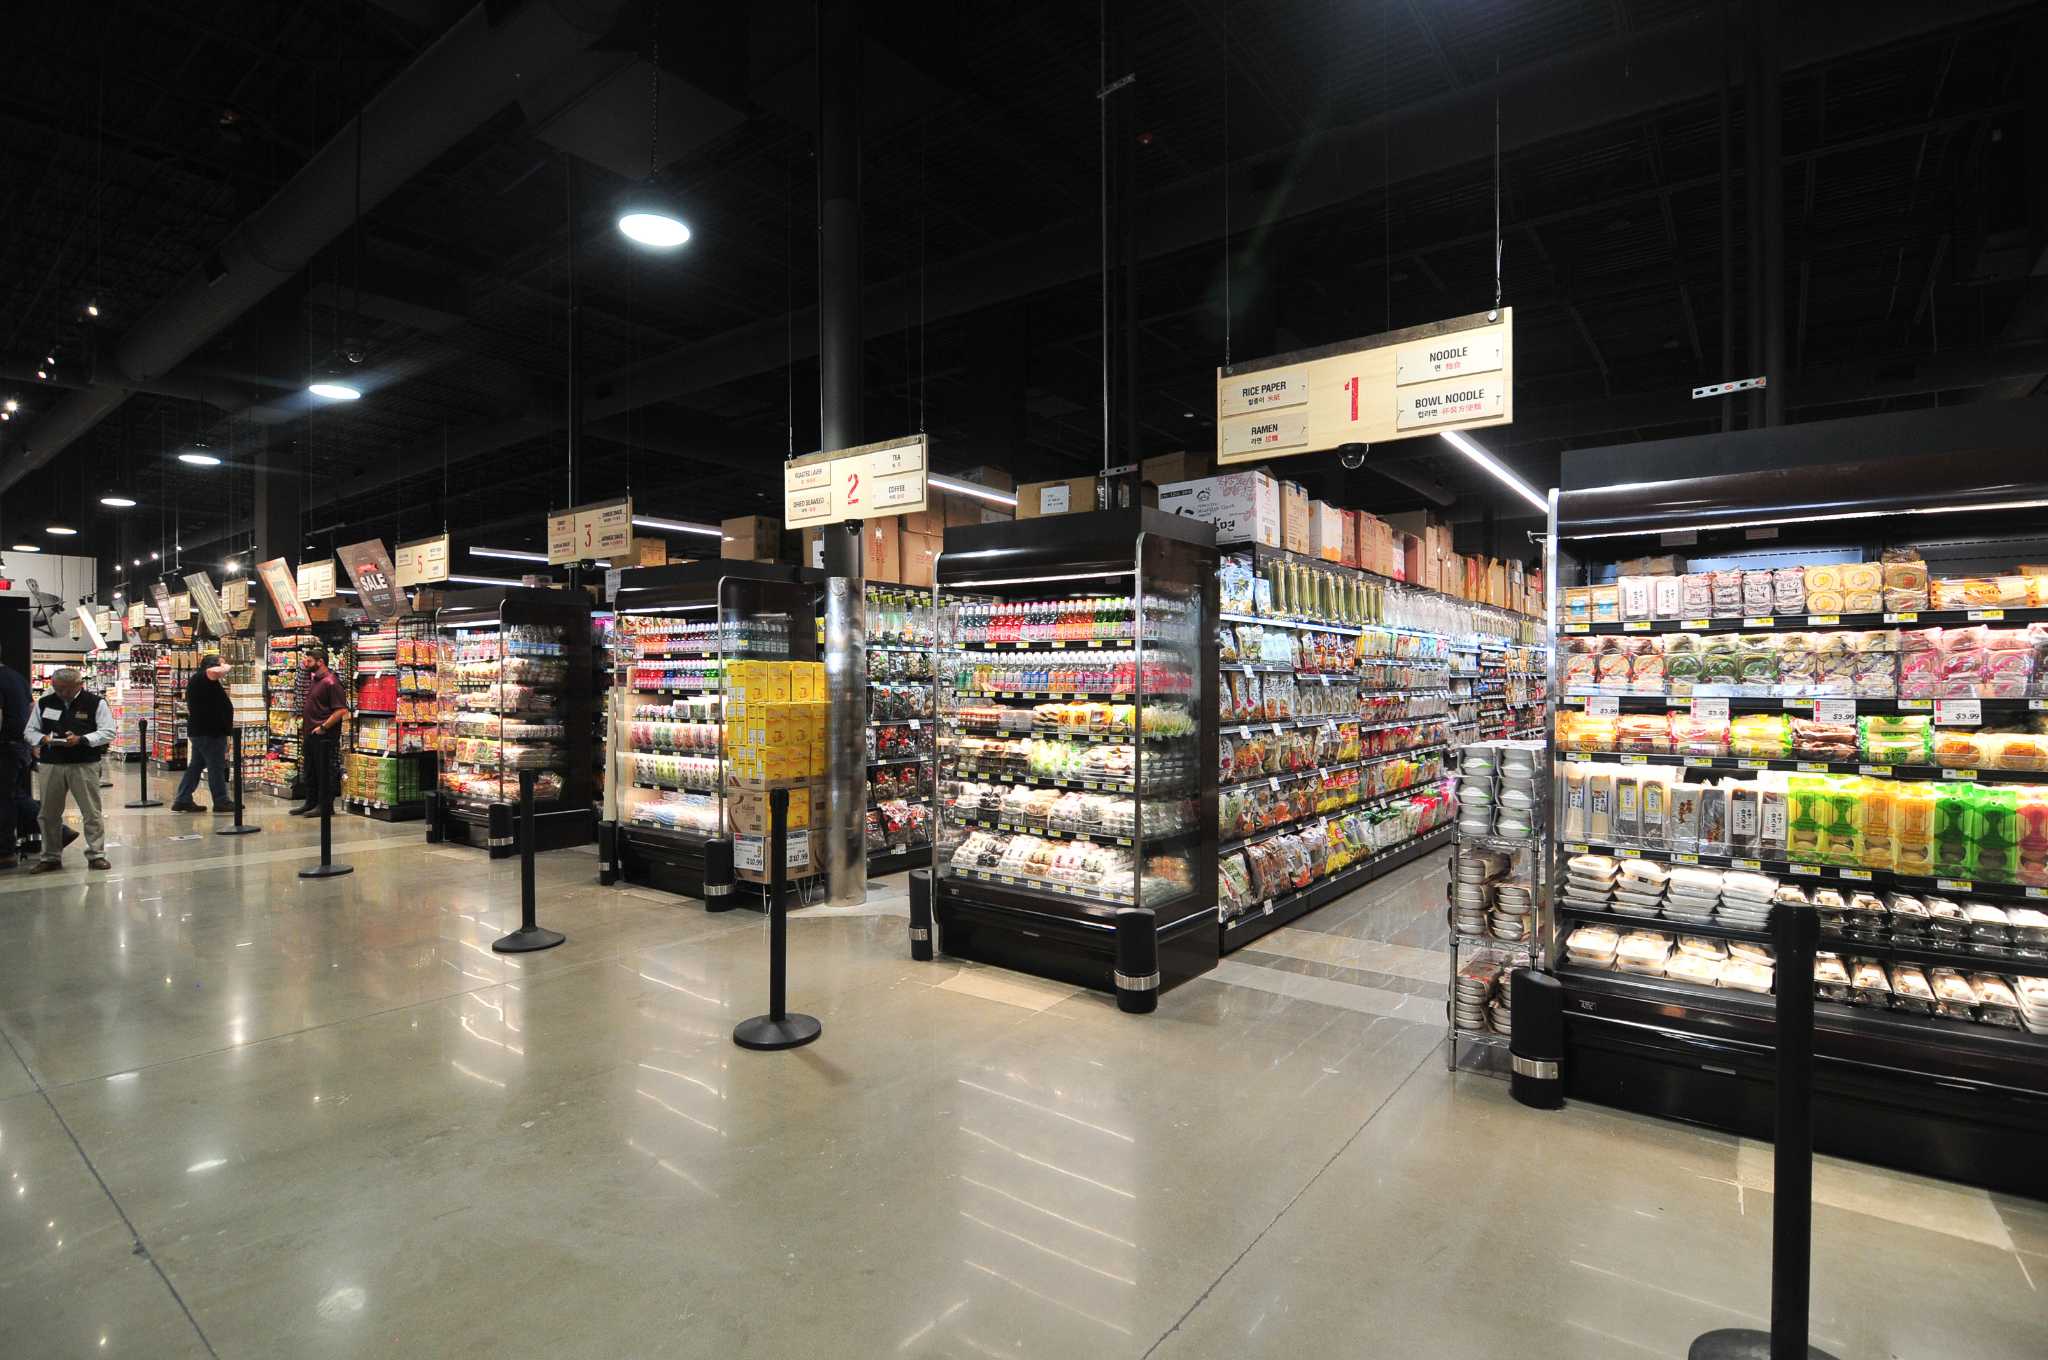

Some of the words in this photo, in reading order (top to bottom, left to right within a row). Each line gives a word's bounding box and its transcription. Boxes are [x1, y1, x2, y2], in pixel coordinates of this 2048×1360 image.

[1429, 346, 1468, 363] NOODLE
[1242, 385, 1260, 397] RICE
[1261, 381, 1287, 393] PAPER
[1344, 377, 1358, 422] 1
[1415, 396, 1443, 409] BOWL
[1445, 389, 1485, 404] NOODLE
[1251, 423, 1278, 435] RAMEN
[847, 473, 859, 505] 2
[888, 484, 905, 494] COFFEE
[584, 523, 592, 548] 3
[360, 573, 389, 592] SALE
